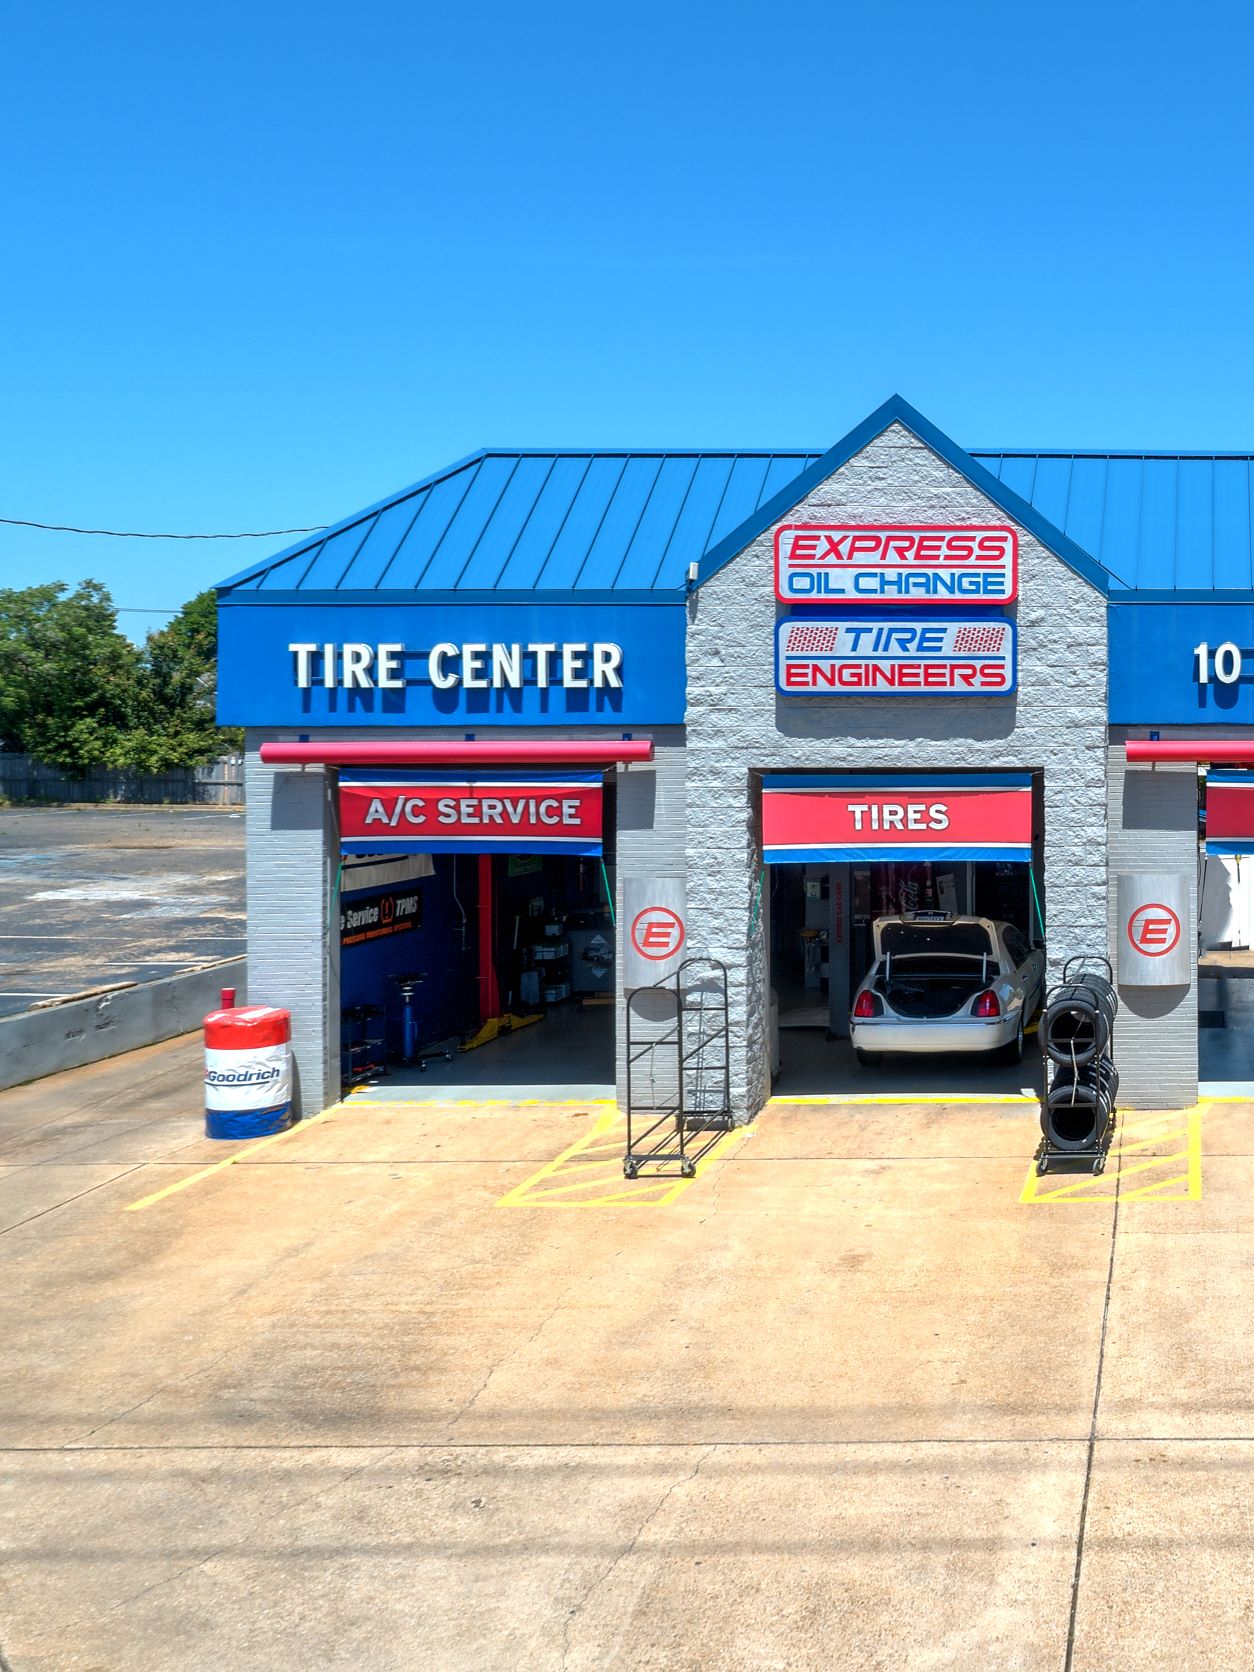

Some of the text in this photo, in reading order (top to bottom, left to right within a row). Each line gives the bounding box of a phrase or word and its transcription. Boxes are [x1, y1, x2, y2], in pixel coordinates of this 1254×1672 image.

[786, 534, 1008, 561] EXPRESS
[788, 572, 1006, 595] OIL CHANGE
[844, 627, 948, 653] TIRE
[289, 643, 624, 689] TIRE CENTER
[785, 663, 1006, 687] ENGINEERS
[1193, 641, 1242, 685] 10
[364, 795, 582, 827] A/C SERVICE
[847, 803, 951, 831] TIRES
[346, 906, 379, 929] Service
[395, 896, 419, 917] TPMS
